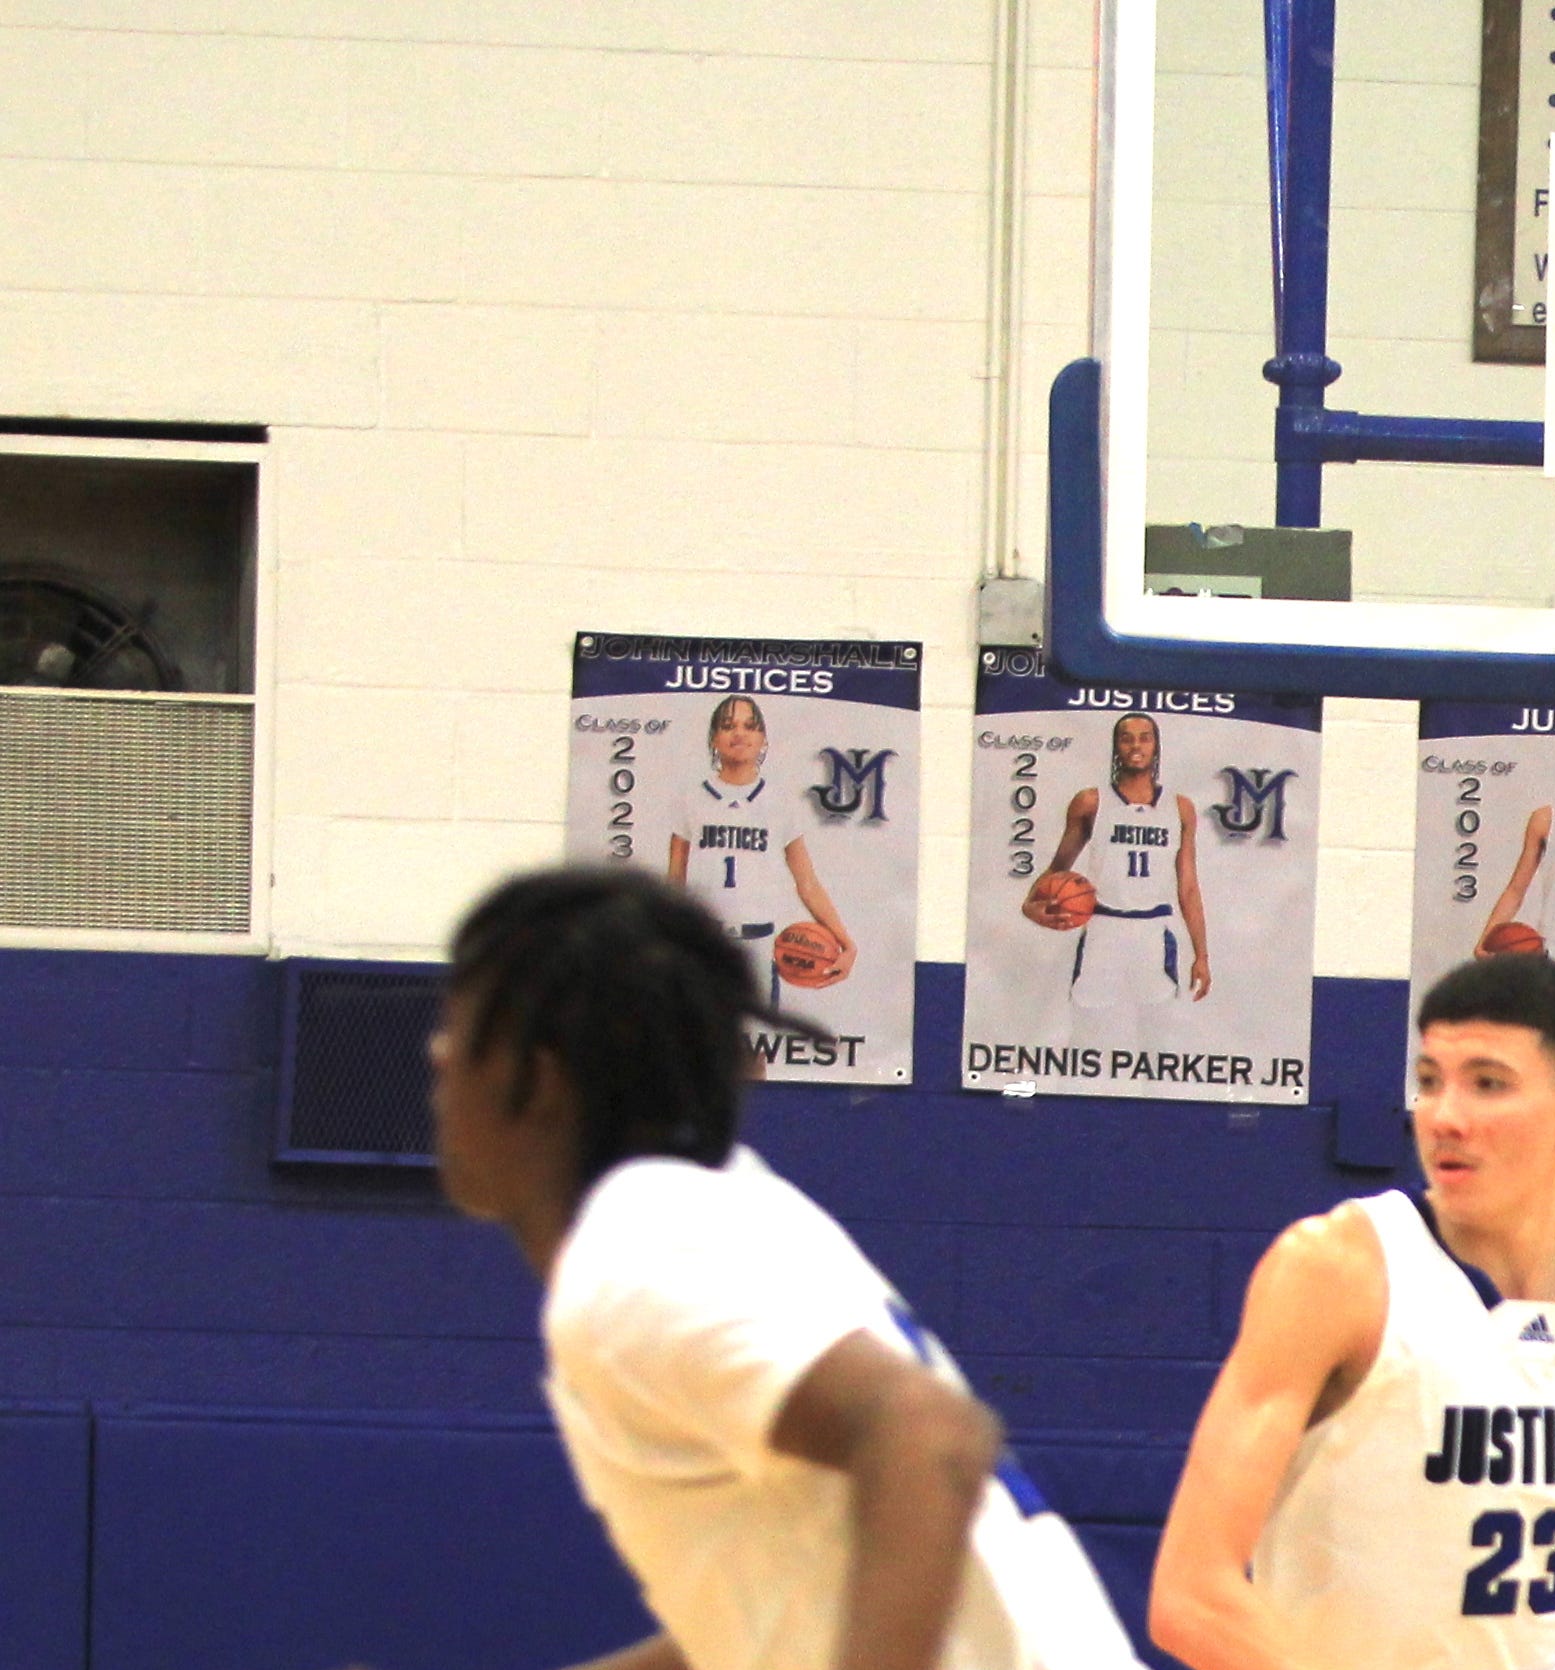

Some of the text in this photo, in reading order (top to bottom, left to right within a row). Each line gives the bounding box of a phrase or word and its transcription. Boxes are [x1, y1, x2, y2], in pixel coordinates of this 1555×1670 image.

[700, 639, 918, 671] MARSHALL
[665, 665, 835, 693] JUSTICES
[1067, 686, 1236, 714] JUSTICES
[699, 824, 769, 853] JUSTICES
[1110, 824, 1170, 848] JUSTICES
[723, 855, 737, 889] 1
[1127, 850, 1151, 878] 11
[741, 1032, 866, 1067] WEST
[968, 1043, 1304, 1088] DENNIS PARKER JR
